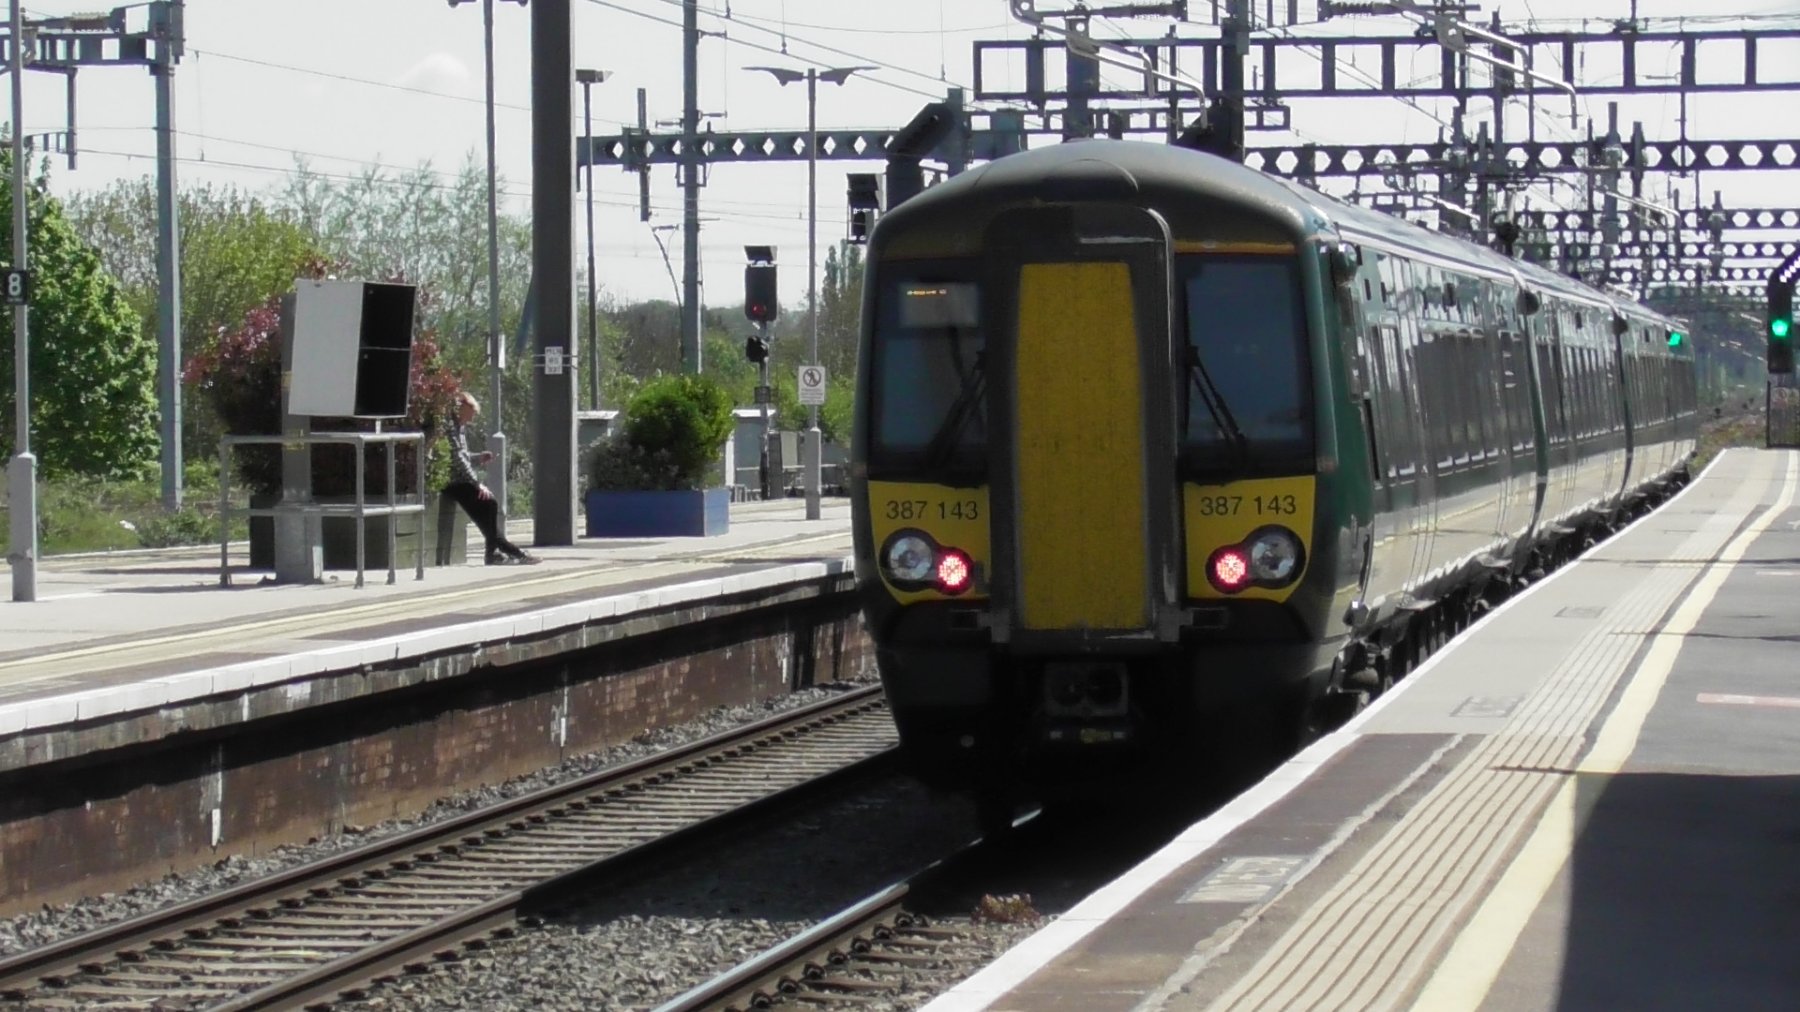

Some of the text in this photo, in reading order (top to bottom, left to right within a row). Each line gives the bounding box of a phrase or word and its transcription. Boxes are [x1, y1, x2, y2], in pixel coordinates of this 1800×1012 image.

[8, 273, 21, 296] 8
[886, 500, 978, 520] 387 143
[1200, 494, 1297, 516] 387 143
